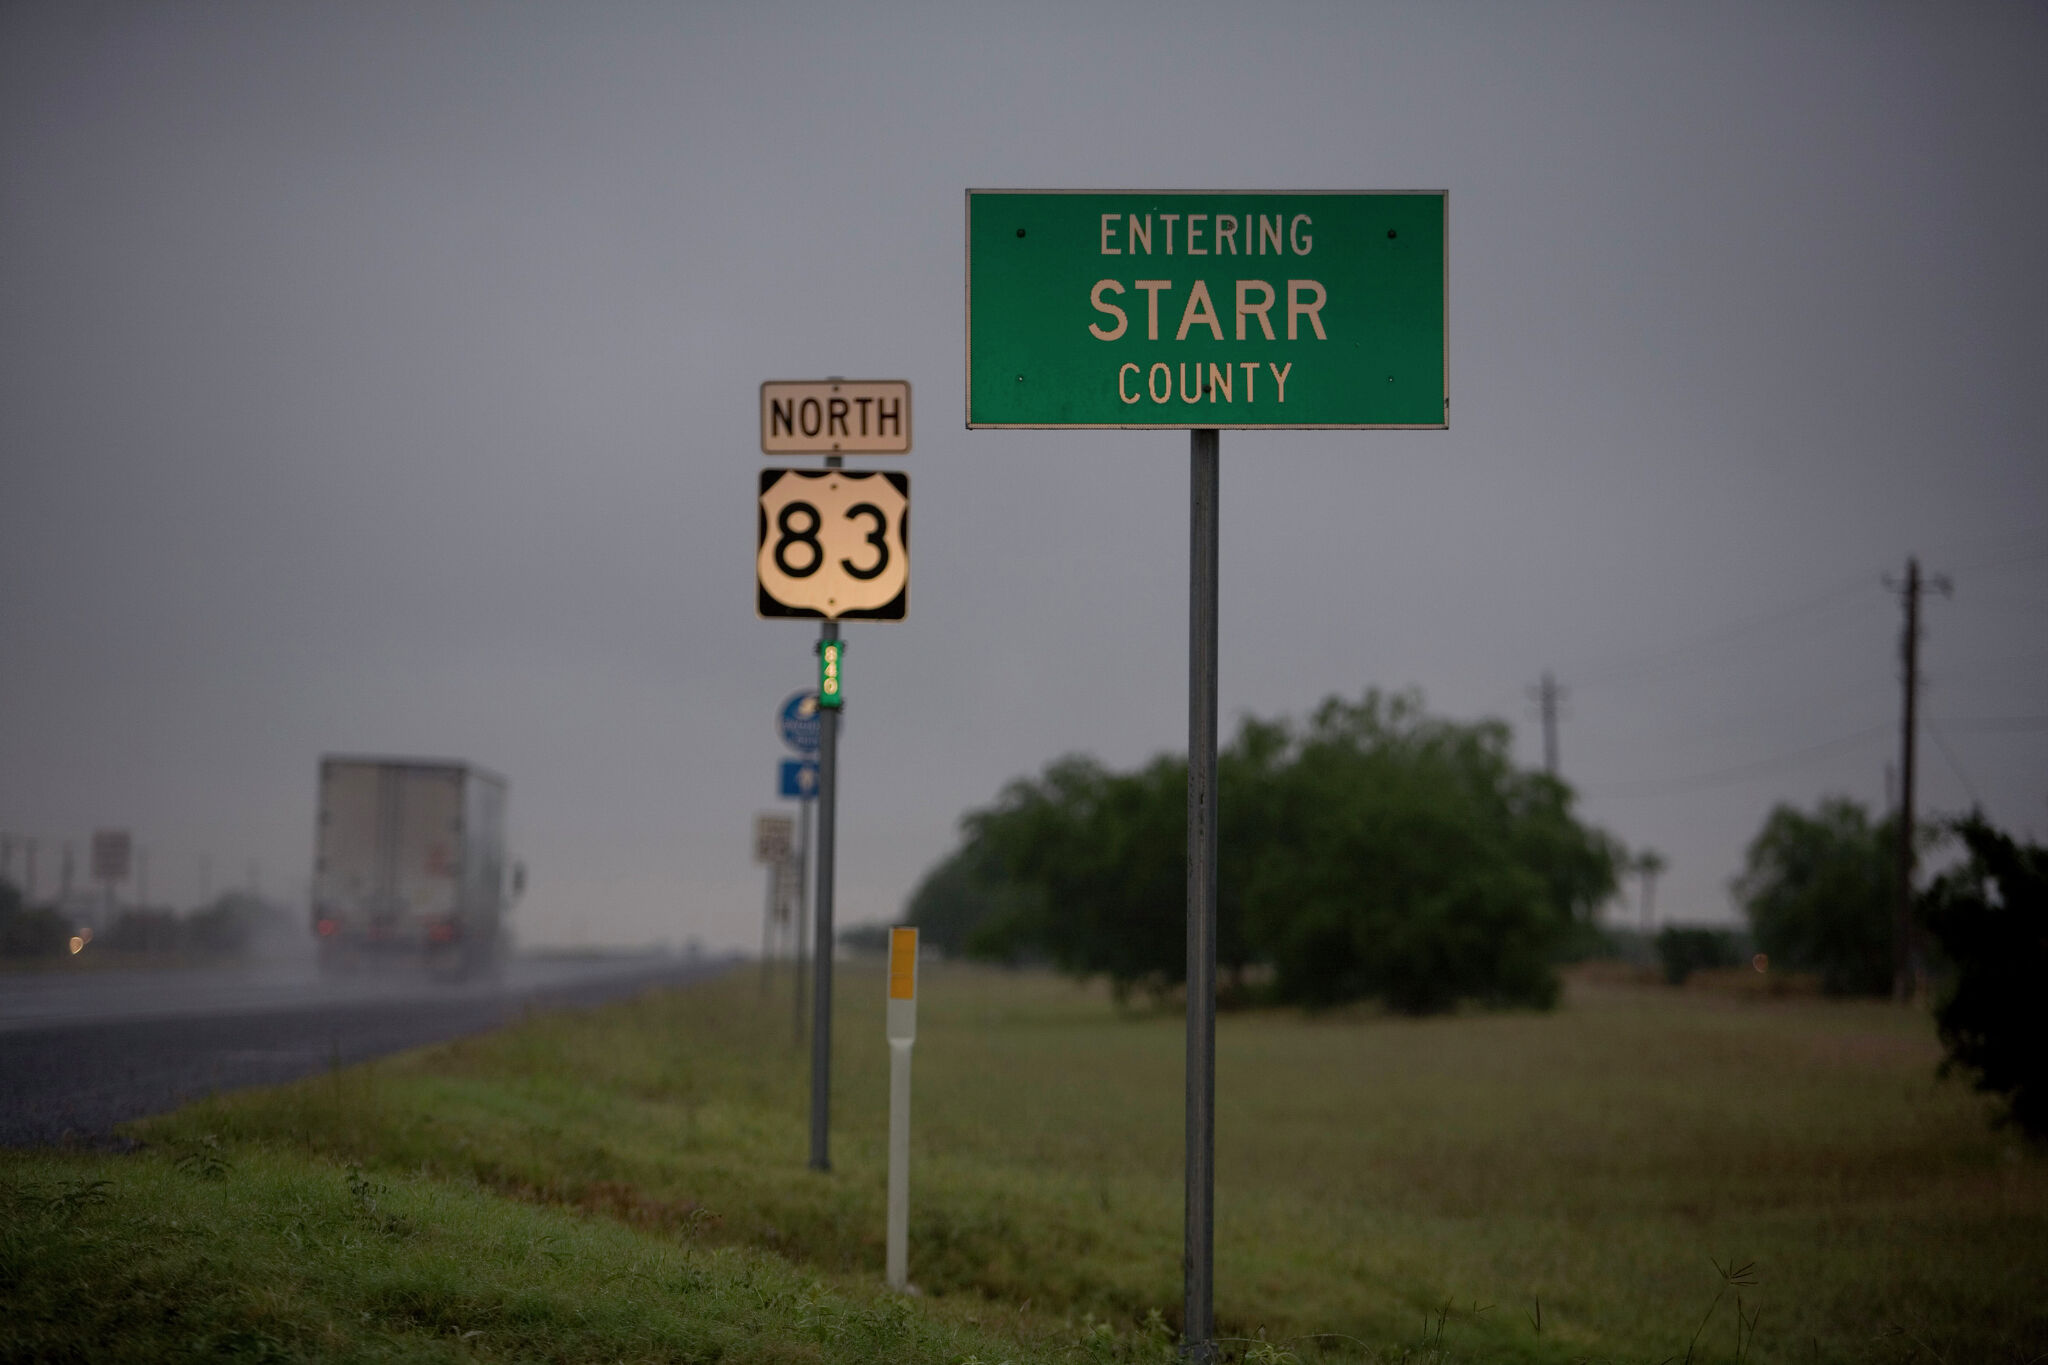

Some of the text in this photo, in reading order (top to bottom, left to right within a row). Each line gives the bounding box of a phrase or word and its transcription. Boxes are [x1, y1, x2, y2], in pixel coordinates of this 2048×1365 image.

[1101, 213, 1313, 256] ENTERING
[1088, 279, 1328, 341] STARR
[1119, 362, 1293, 404] COUNTY
[771, 398, 901, 437] NORTH
[774, 501, 890, 580] 83
